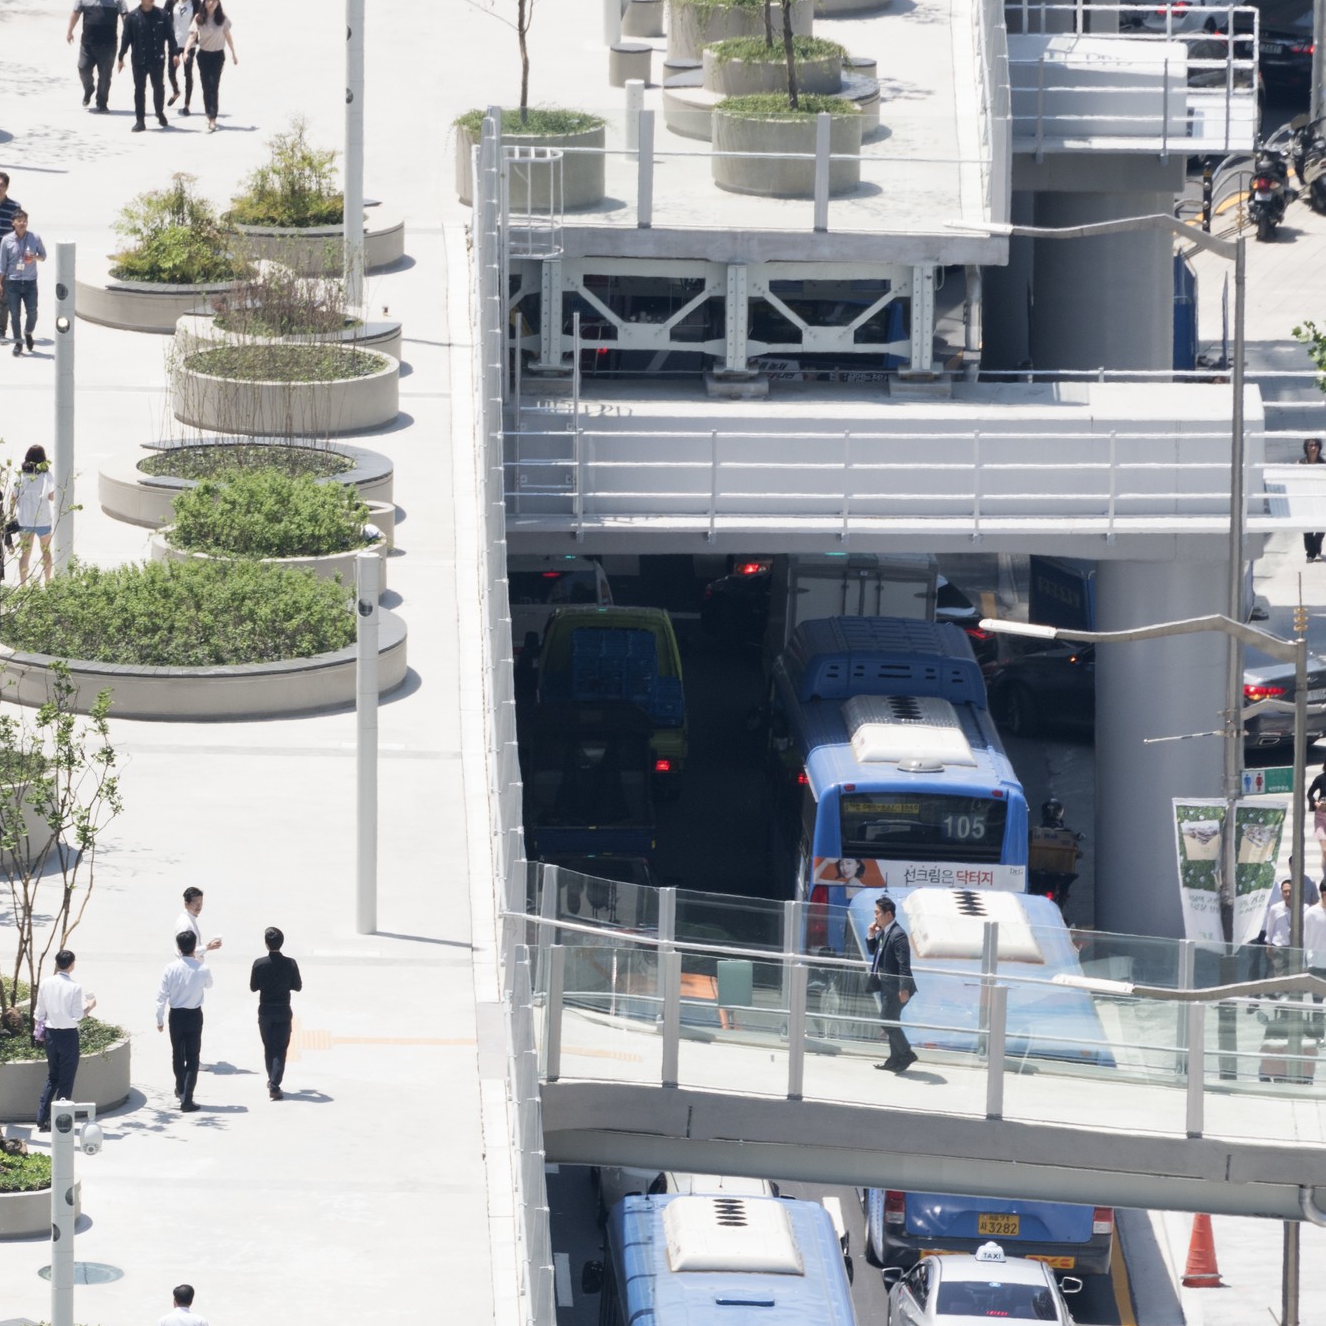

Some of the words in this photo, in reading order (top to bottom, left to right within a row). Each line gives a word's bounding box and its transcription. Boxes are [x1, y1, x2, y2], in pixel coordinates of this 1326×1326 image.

[944, 816, 986, 839] 105
[904, 867, 955, 887] 선크림은
[956, 870, 994, 886] 닥터지
[988, 1222, 1018, 1234] 3282
[983, 1252, 1002, 1260] TAXI
